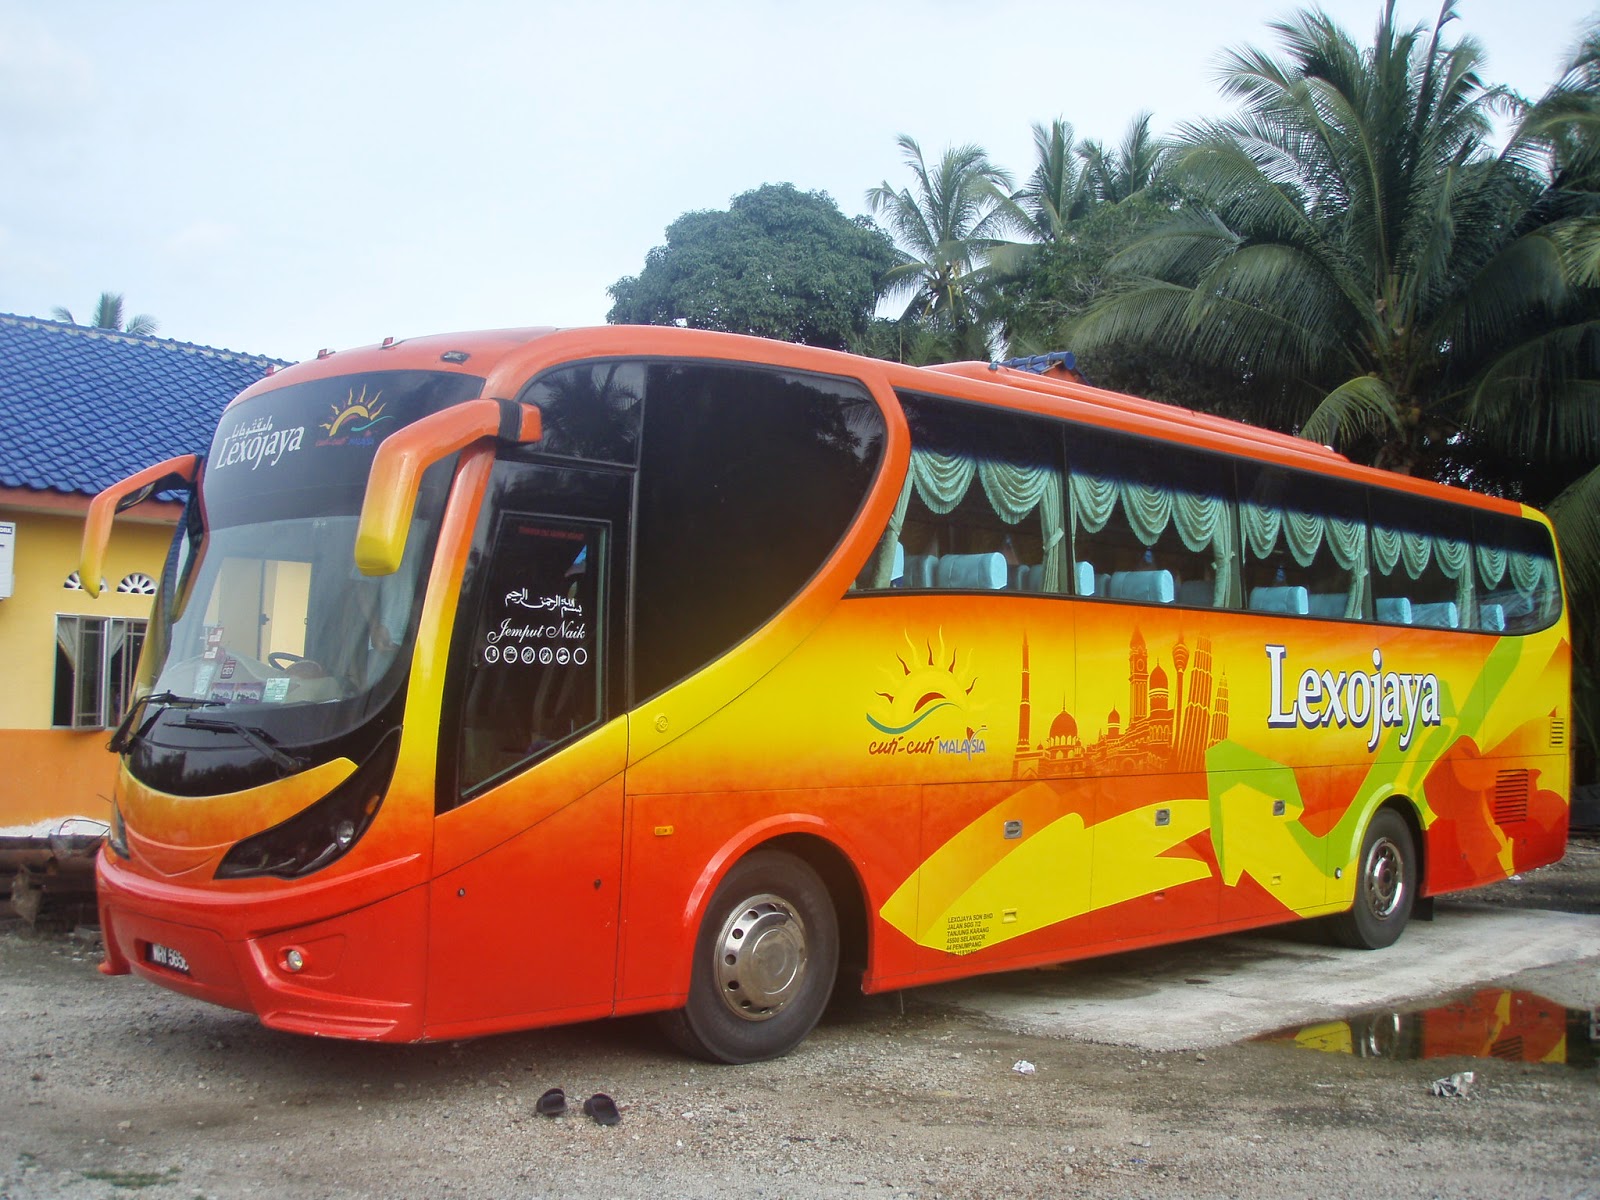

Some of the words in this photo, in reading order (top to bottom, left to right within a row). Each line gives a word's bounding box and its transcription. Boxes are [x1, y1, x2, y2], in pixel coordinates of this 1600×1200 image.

[215, 426, 305, 471] Lexojaya
[486, 618, 545, 645] Jemput
[545, 620, 586, 640] Naik
[1265, 644, 1441, 753] Lexojaya
[868, 736, 940, 755] cuti-cuti
[938, 738, 986, 761] MALAYSIA
[947, 915, 973, 923] LEXOJAYA
[947, 922, 963, 930] JALAN
[947, 929, 969, 937] TANJUNG
[970, 926, 989, 934] KARANG
[960, 934, 986, 942] SELANGOR
[952, 941, 982, 950] PENUMPANG
